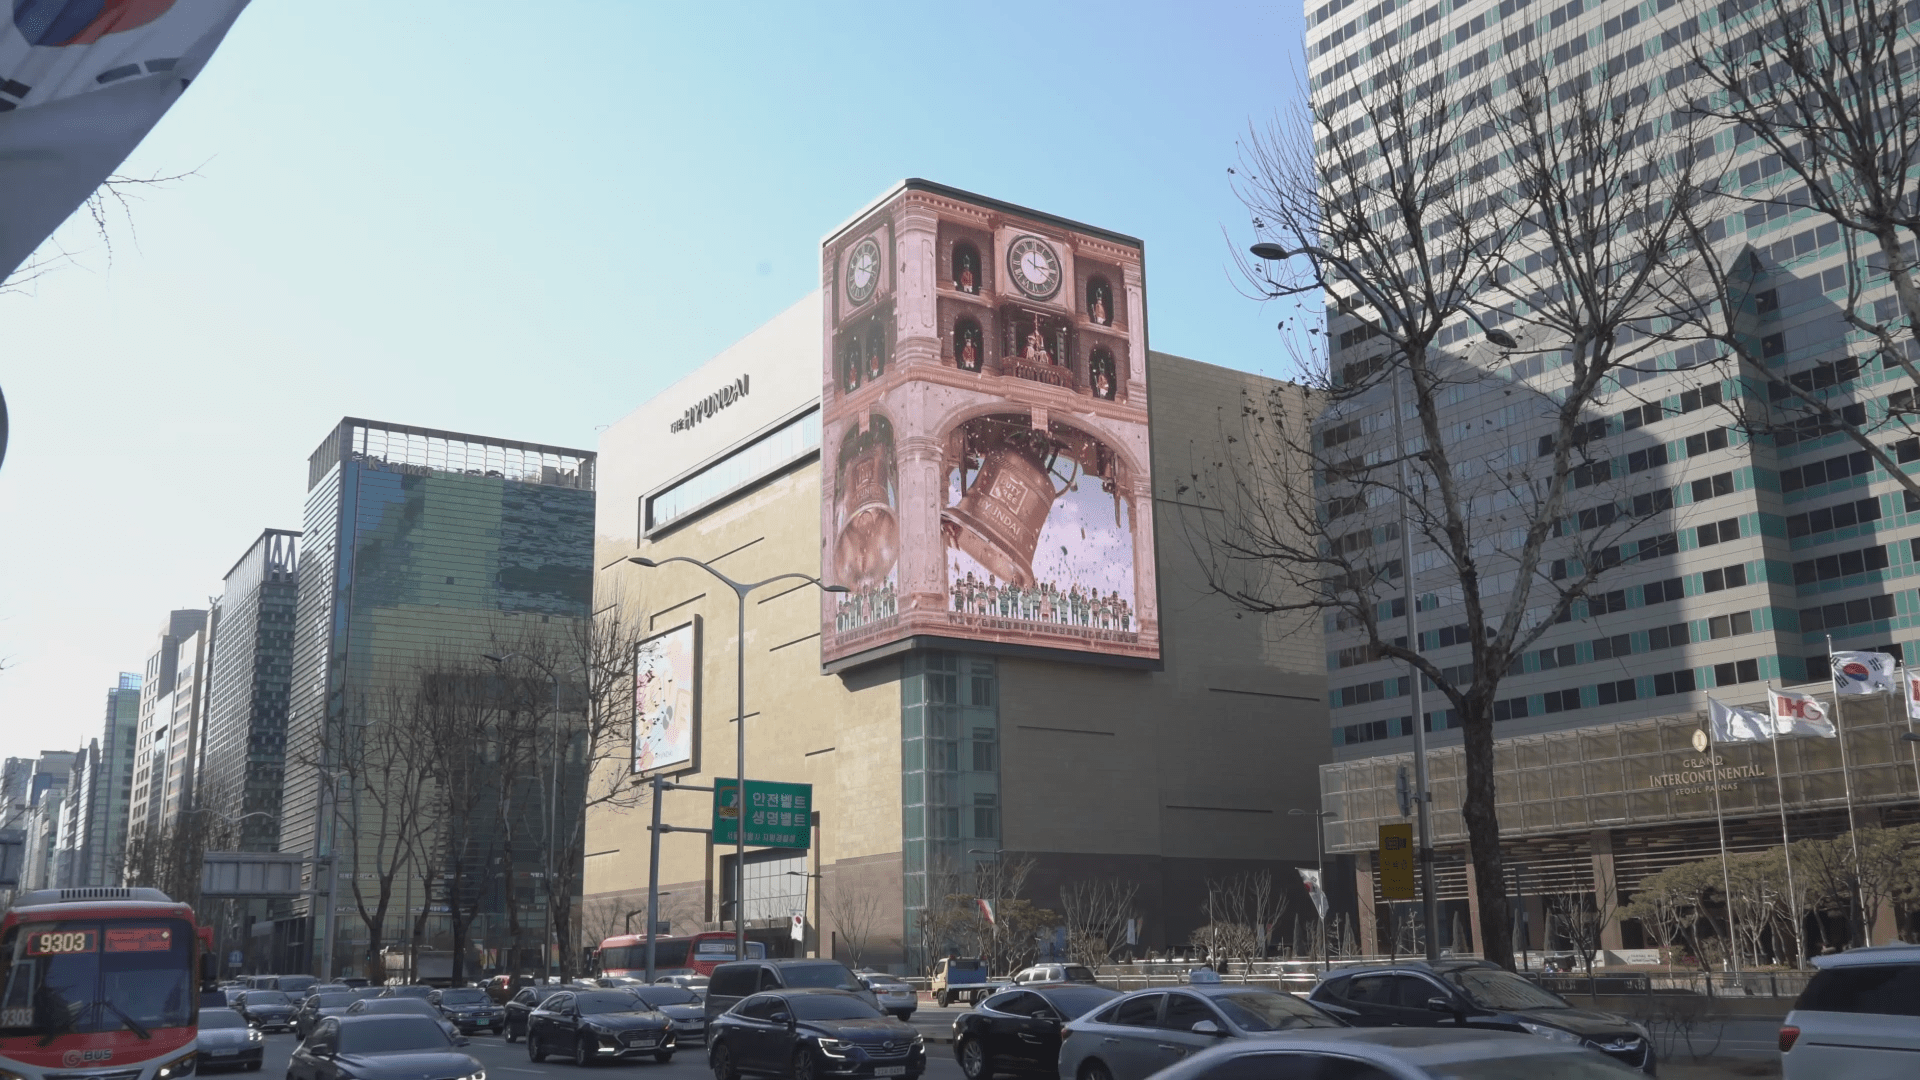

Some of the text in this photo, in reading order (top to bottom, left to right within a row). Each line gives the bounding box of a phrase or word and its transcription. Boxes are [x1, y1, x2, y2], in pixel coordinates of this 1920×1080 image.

[684, 373, 749, 431] HYUNDAI
[999, 486, 1018, 505] REE
[1778, 696, 1822, 721] IHG
[1683, 756, 1723, 768] GRAND
[1649, 765, 1763, 788] INTERCONTNENTAL
[753, 792, 806, 808] 안전벨트
[1675, 787, 1702, 796] SEOUL
[752, 811, 806, 827] 생명벨트
[40, 932, 86, 953] 9303
[1, 1008, 34, 1027] 9303
[84, 1049, 113, 1061] BUS
